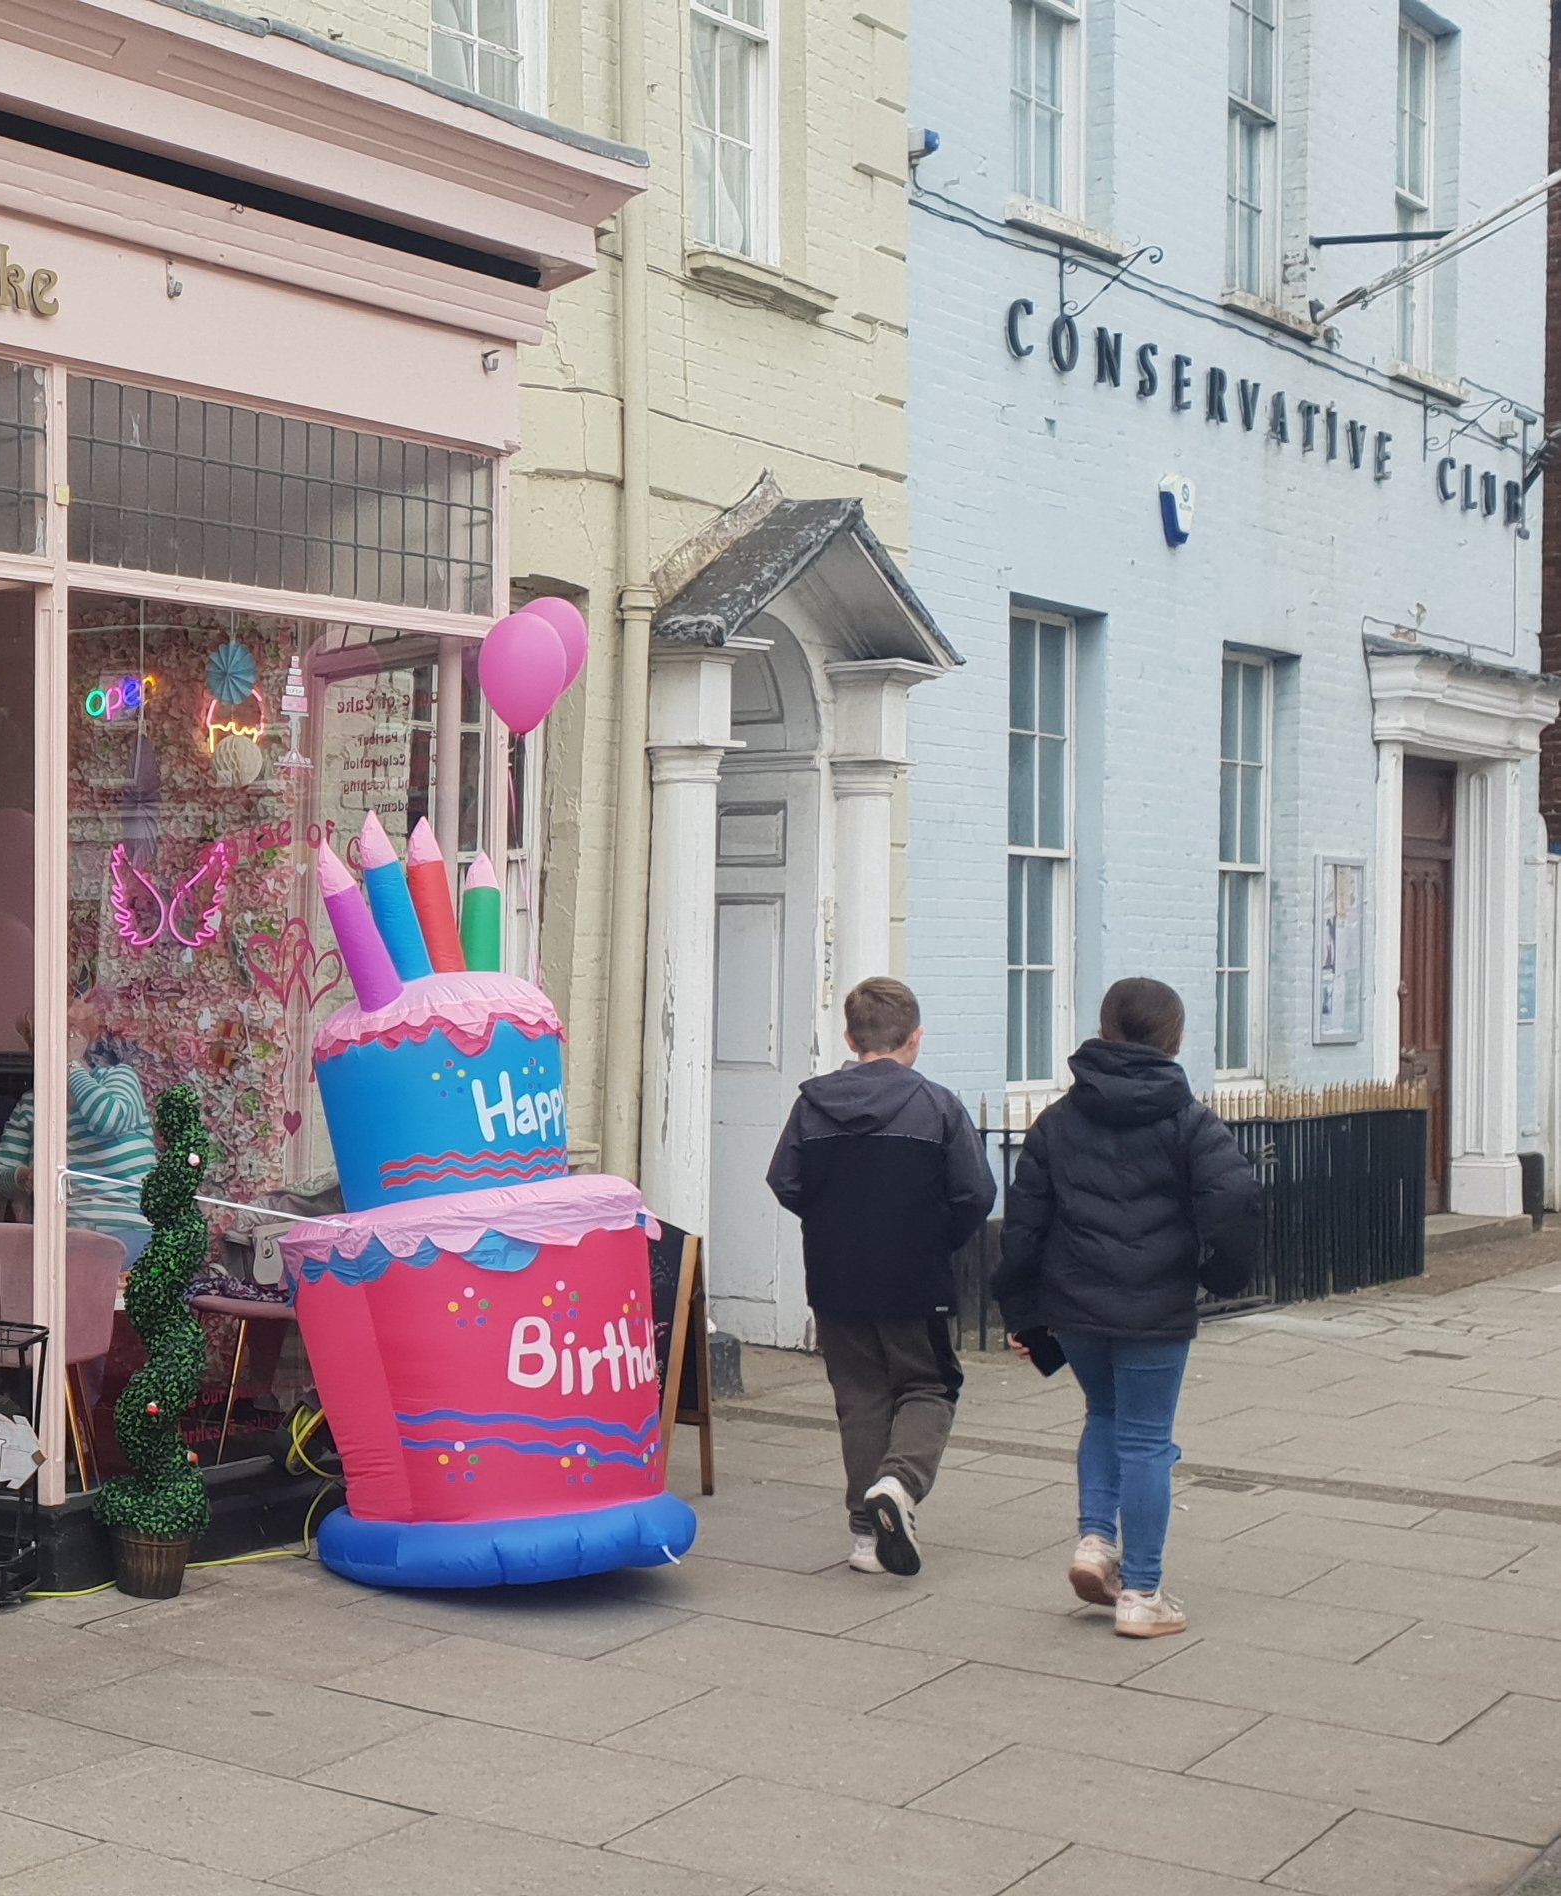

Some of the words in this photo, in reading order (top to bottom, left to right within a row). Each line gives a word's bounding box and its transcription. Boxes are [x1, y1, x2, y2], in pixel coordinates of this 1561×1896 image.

[1005, 296, 1393, 483] CONSERVATIVE
[1436, 456, 1522, 527] CLUB
[471, 1070, 567, 1142] Happ
[507, 1316, 658, 1396] Birthd
